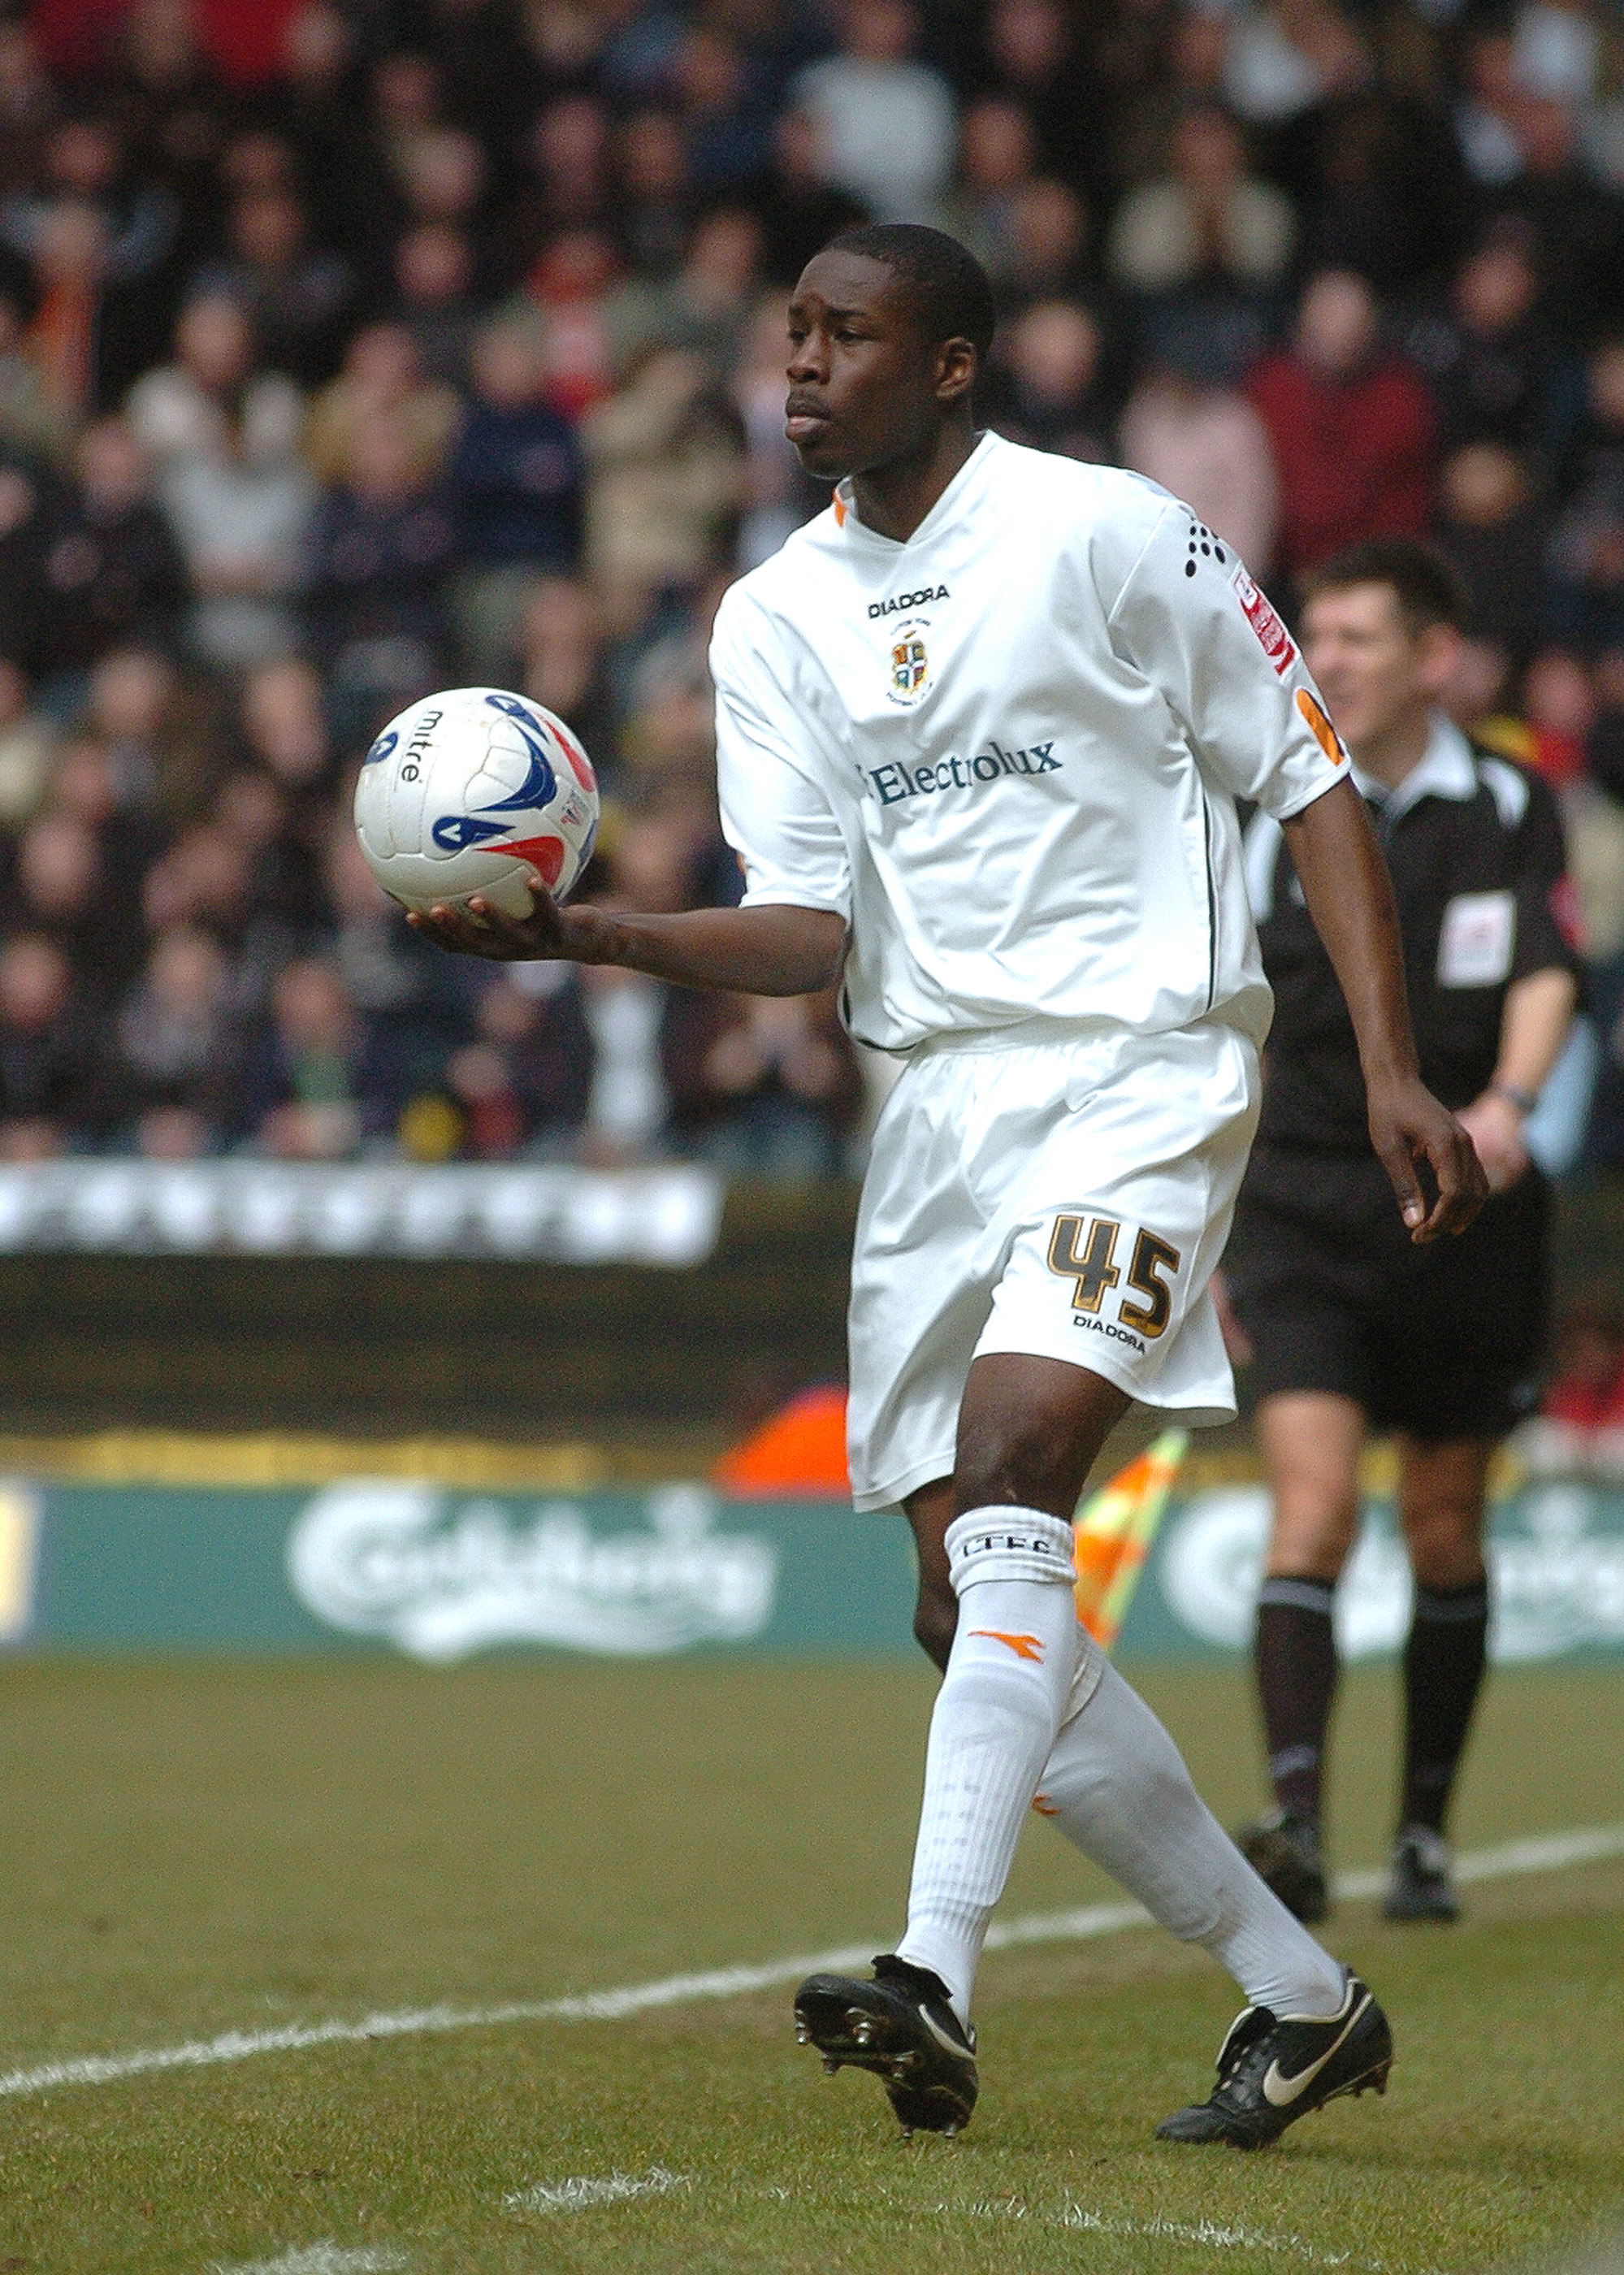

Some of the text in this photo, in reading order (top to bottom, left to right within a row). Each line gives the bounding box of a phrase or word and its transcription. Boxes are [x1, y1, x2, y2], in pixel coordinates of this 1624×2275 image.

[868, 584, 950, 618] DIADORA
[401, 710, 444, 782] mitre
[868, 740, 1063, 806] Electrolux
[1047, 1215, 1180, 1339] 45
[1073, 1315, 1145, 1354] DIADORA
